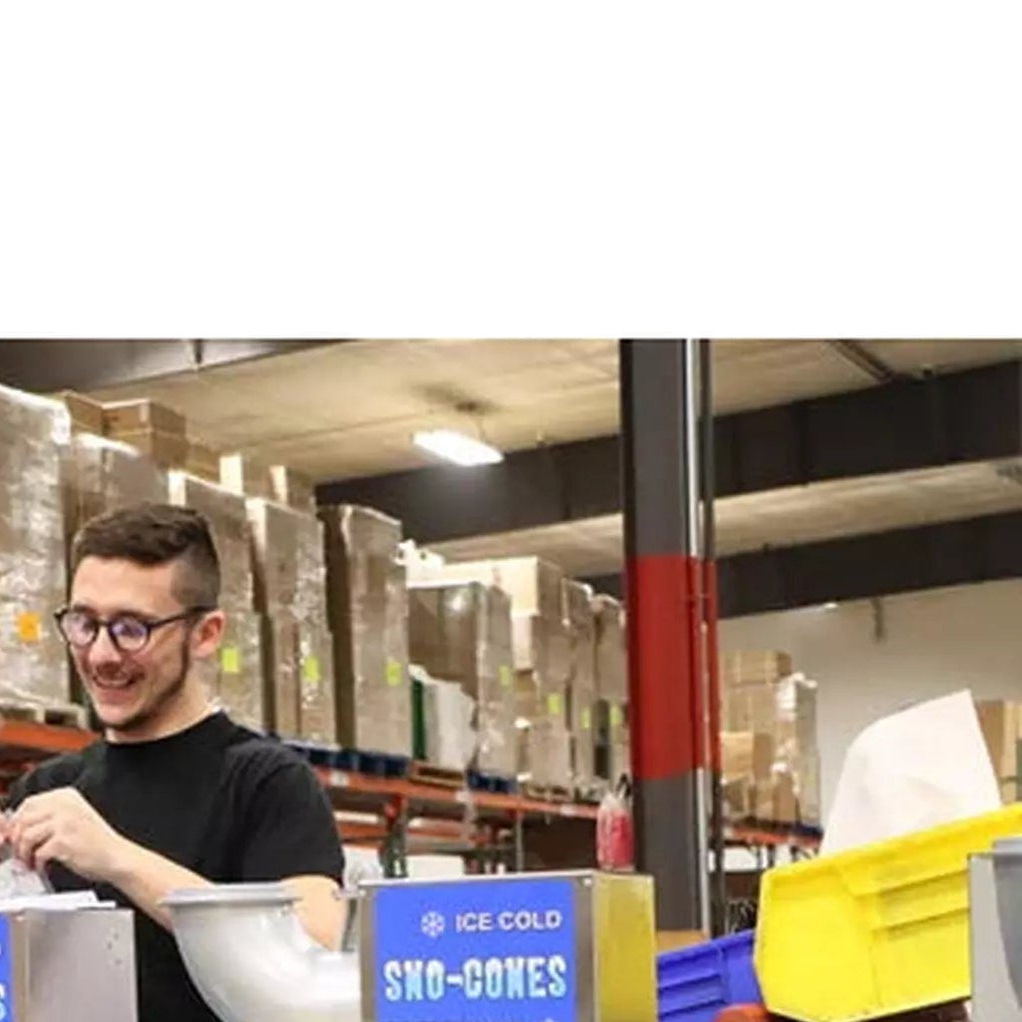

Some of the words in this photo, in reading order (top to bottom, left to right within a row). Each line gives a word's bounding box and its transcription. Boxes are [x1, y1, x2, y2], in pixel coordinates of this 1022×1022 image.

[455, 912, 494, 932] ICE
[498, 909, 562, 931] COLD
[383, 955, 567, 1001] SNO-CONES
